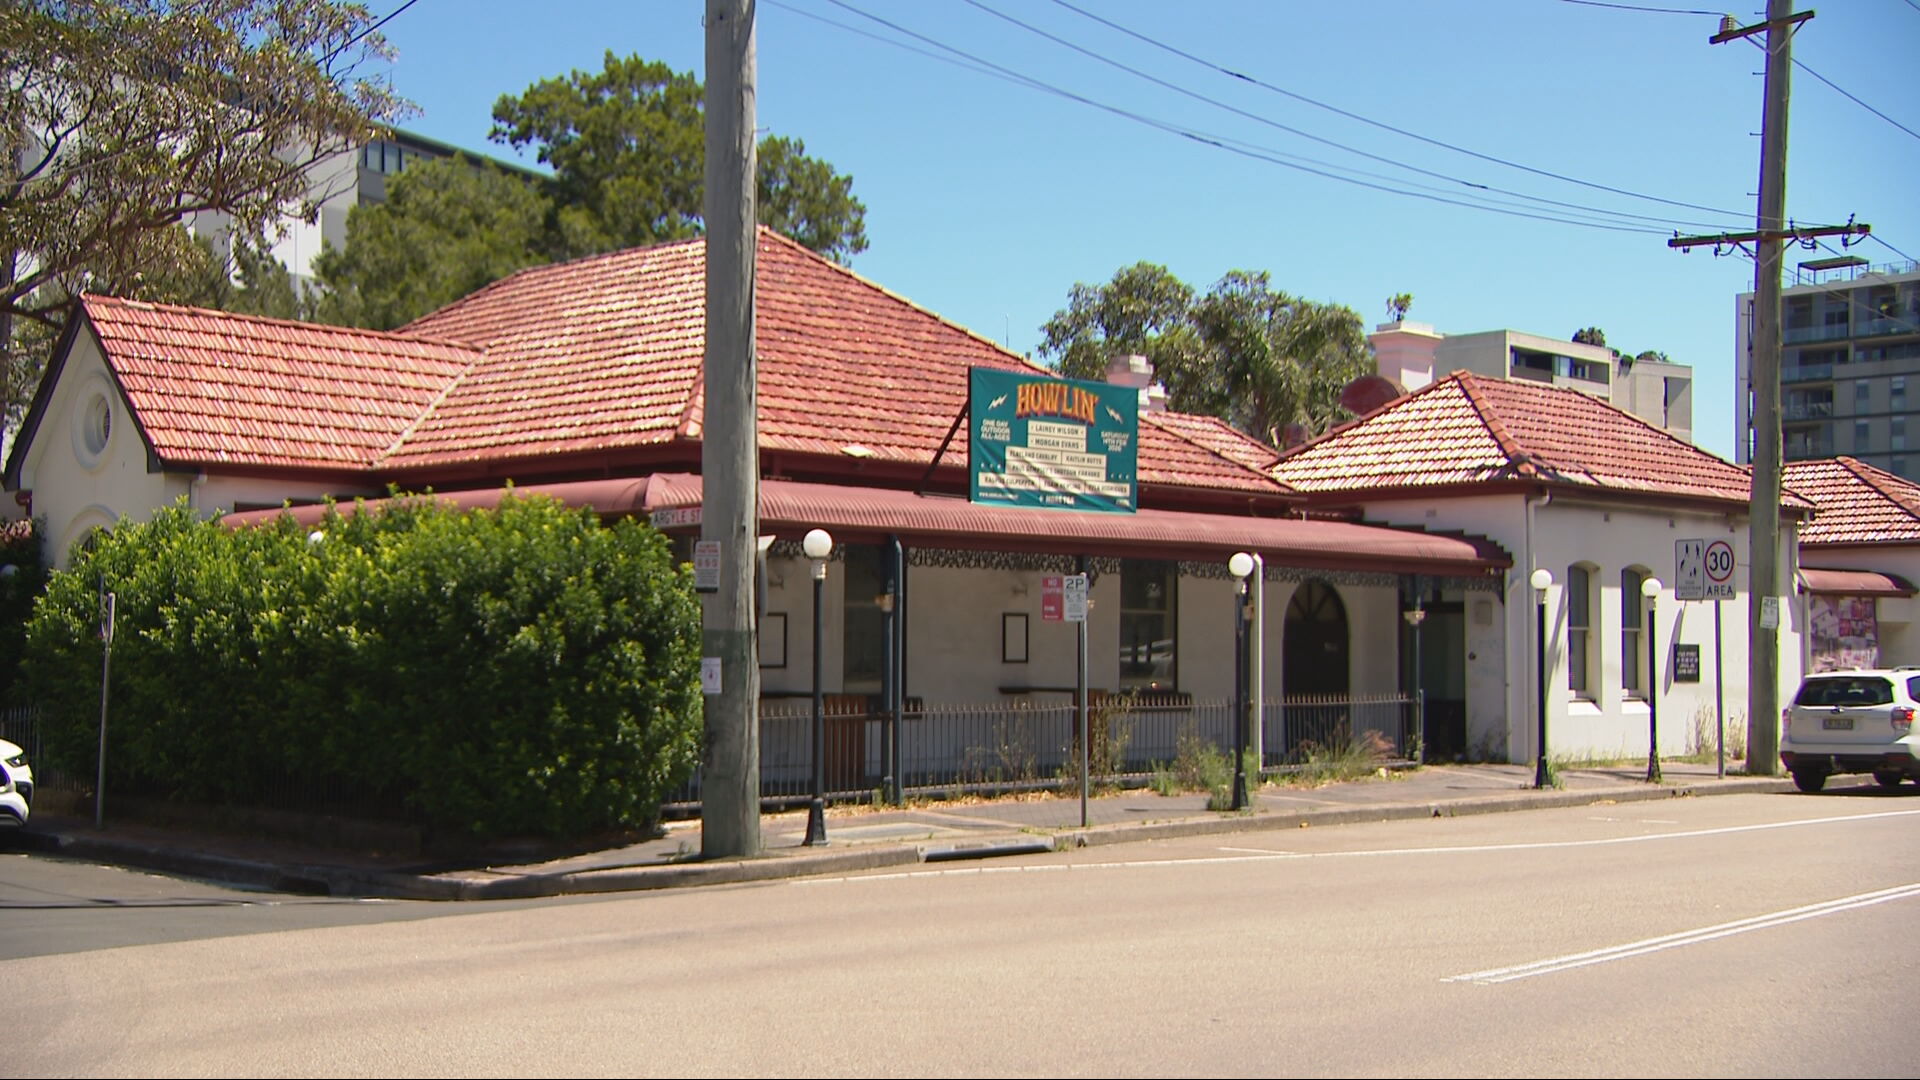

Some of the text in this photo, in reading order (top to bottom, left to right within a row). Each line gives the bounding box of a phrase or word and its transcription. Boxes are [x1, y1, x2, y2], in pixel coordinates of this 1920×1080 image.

[1057, 426, 1078, 435] WILSON
[1035, 438, 1079, 449] MORGAN EVANS
[654, 510, 687, 526] ARGYLE
[1709, 551, 1730, 571] 30
[1066, 578, 1084, 589] 2P
[1707, 585, 1733, 596] AREA
